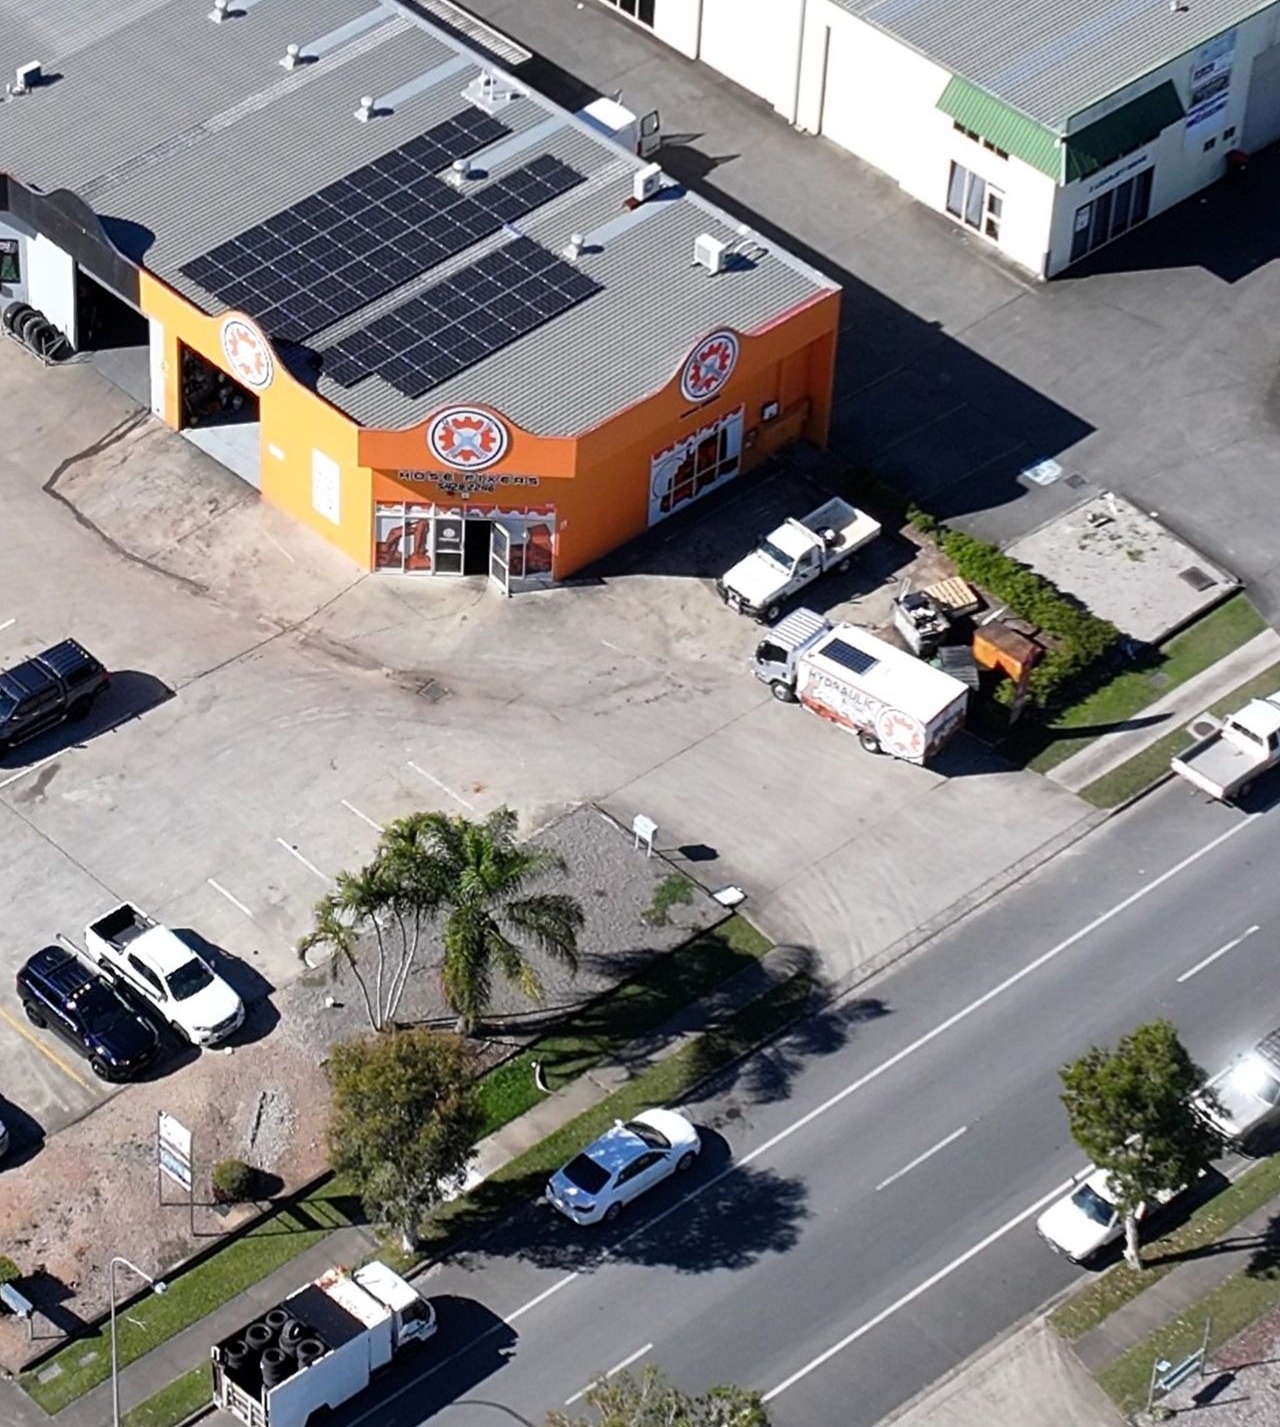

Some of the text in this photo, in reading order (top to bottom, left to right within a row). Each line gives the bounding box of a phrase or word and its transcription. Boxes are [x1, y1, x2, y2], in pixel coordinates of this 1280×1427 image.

[398, 472, 539, 486] HOSE FIXERS
[809, 669, 875, 711] HYDRAULIC
